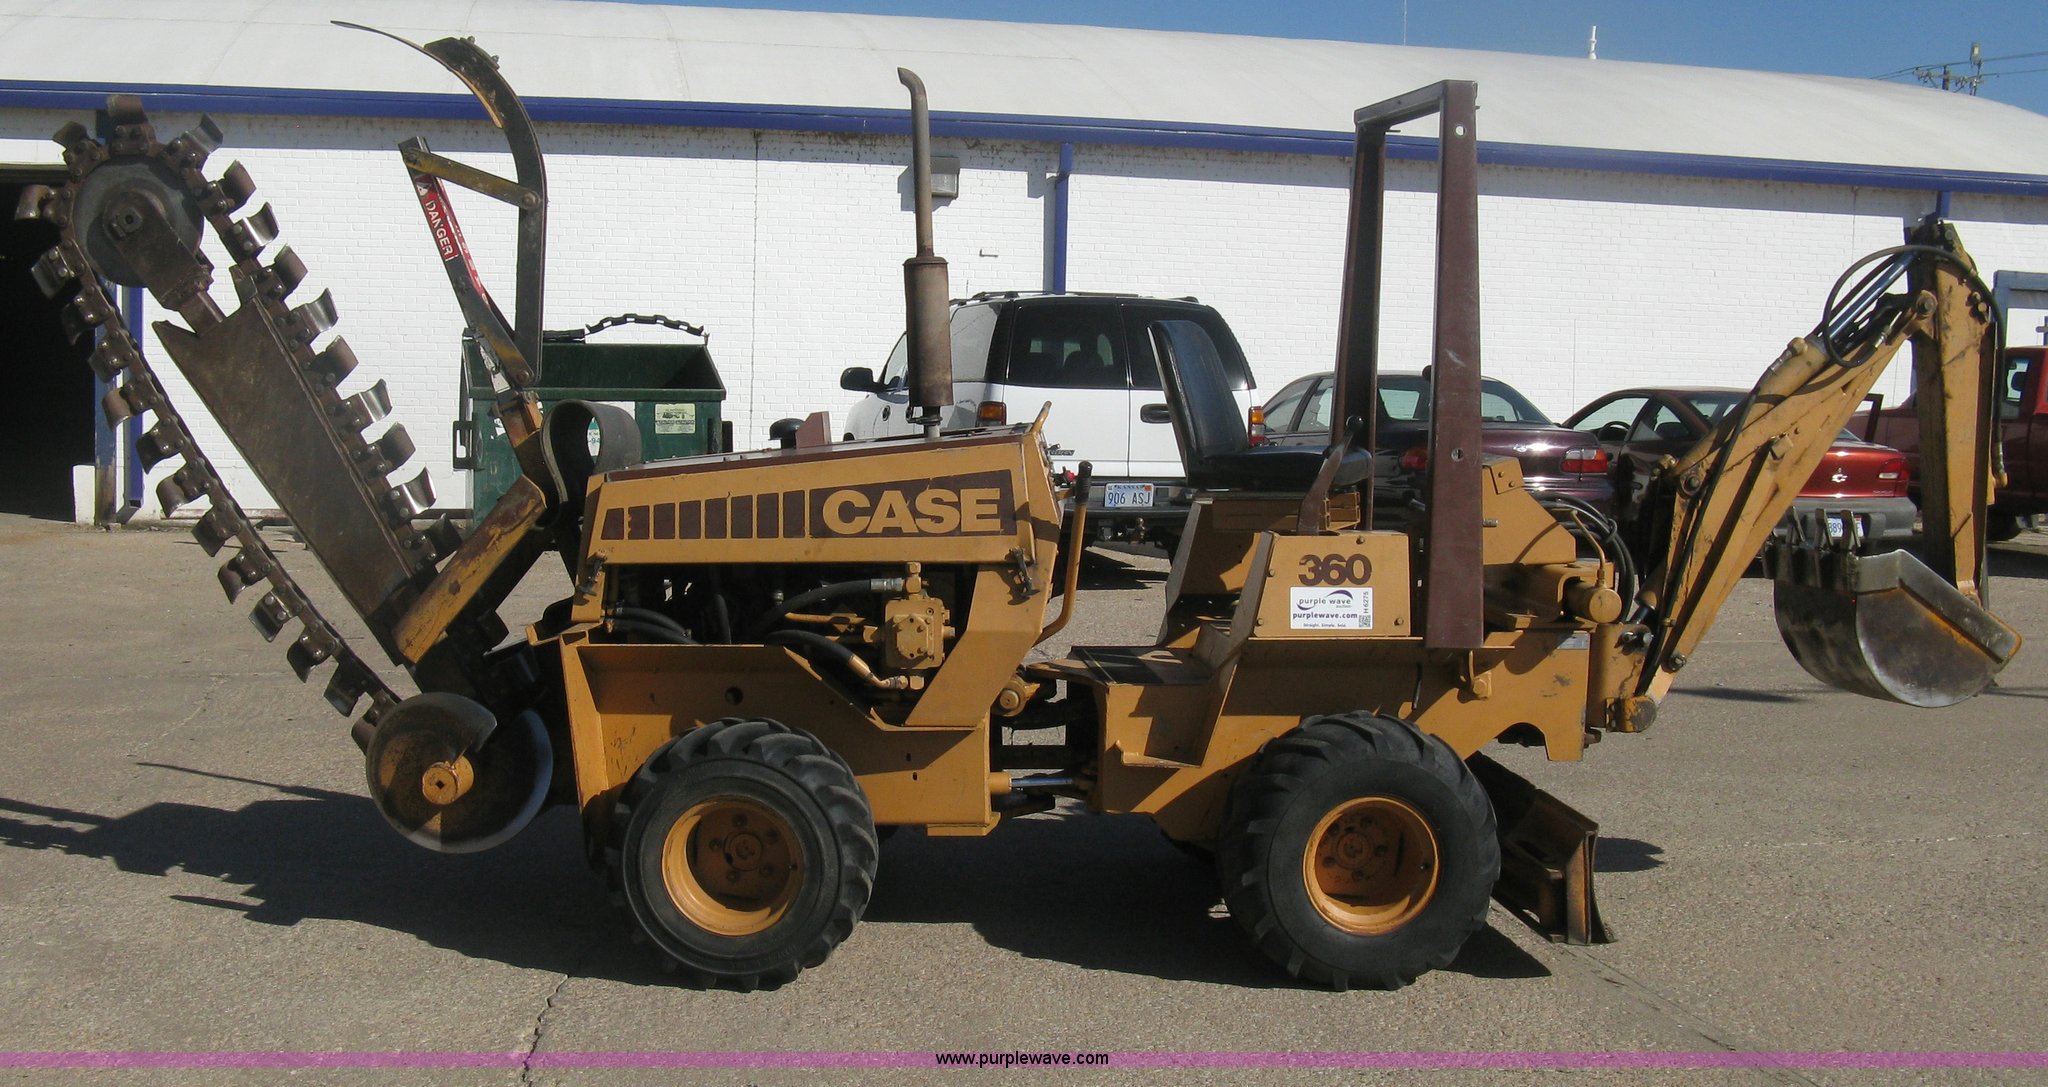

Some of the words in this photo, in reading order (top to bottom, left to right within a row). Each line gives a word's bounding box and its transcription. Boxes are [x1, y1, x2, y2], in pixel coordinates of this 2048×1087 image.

[425, 200, 454, 256] DANGER
[822, 487, 1001, 534] CASE
[1108, 492, 1126, 504] 906
[1132, 492, 1150, 504] ASJ
[1298, 553, 1372, 586] 360
